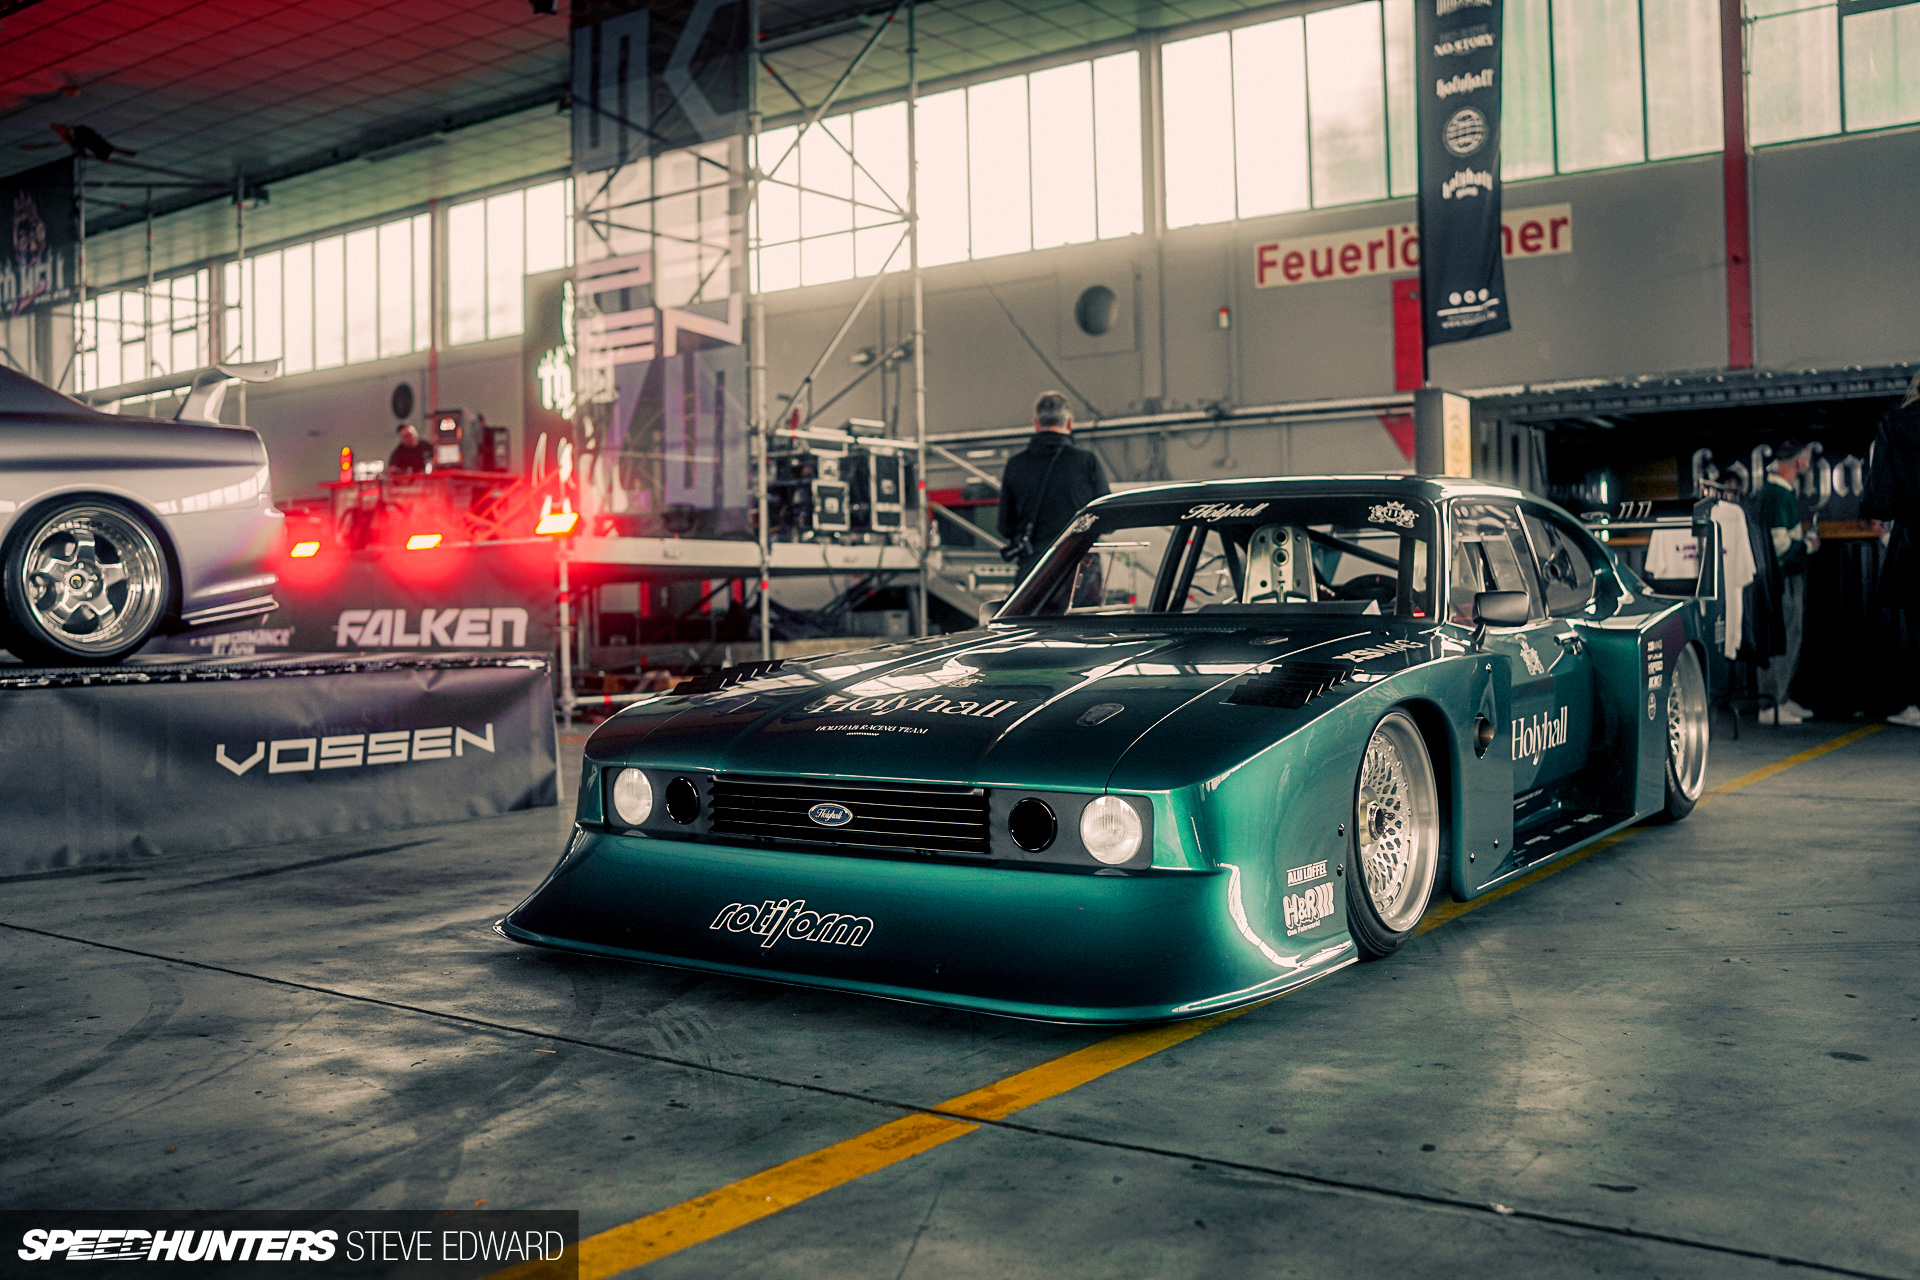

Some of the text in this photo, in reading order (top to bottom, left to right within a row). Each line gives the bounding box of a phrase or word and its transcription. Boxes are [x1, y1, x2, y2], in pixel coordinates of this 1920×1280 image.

[1181, 502, 1269, 522] Holyhall
[336, 607, 529, 647] FALKEN
[808, 694, 1018, 718] Holyhall
[898, 726, 929, 735] TEAM
[1511, 705, 1568, 766] Holyhall
[216, 723, 495, 776] VOSSEN
[1288, 869, 1303, 884] ALU
[709, 898, 874, 948] rotiform
